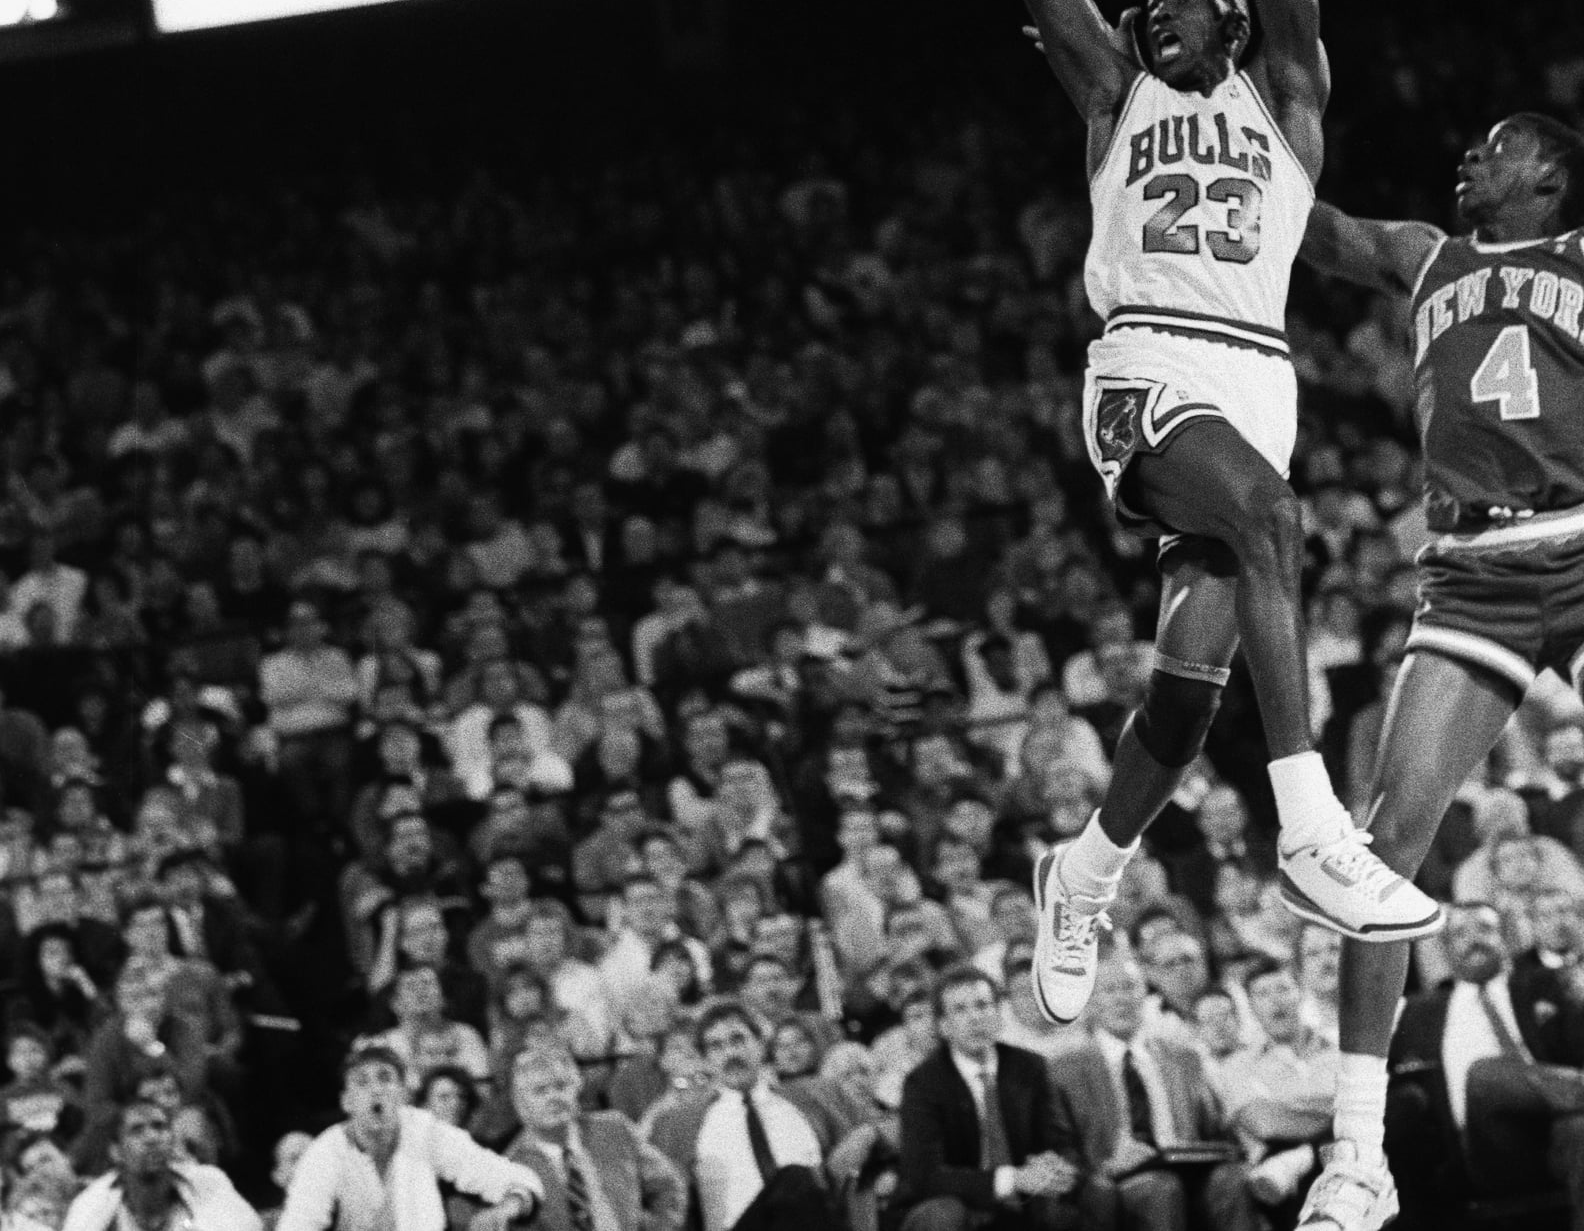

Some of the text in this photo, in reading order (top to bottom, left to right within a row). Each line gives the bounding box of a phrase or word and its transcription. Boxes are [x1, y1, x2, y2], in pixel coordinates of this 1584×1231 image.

[1126, 112, 1271, 188] BULLS
[1143, 174, 1262, 264] 23
[1499, 267, 1584, 345] YOR
[1470, 324, 1541, 419] 4
